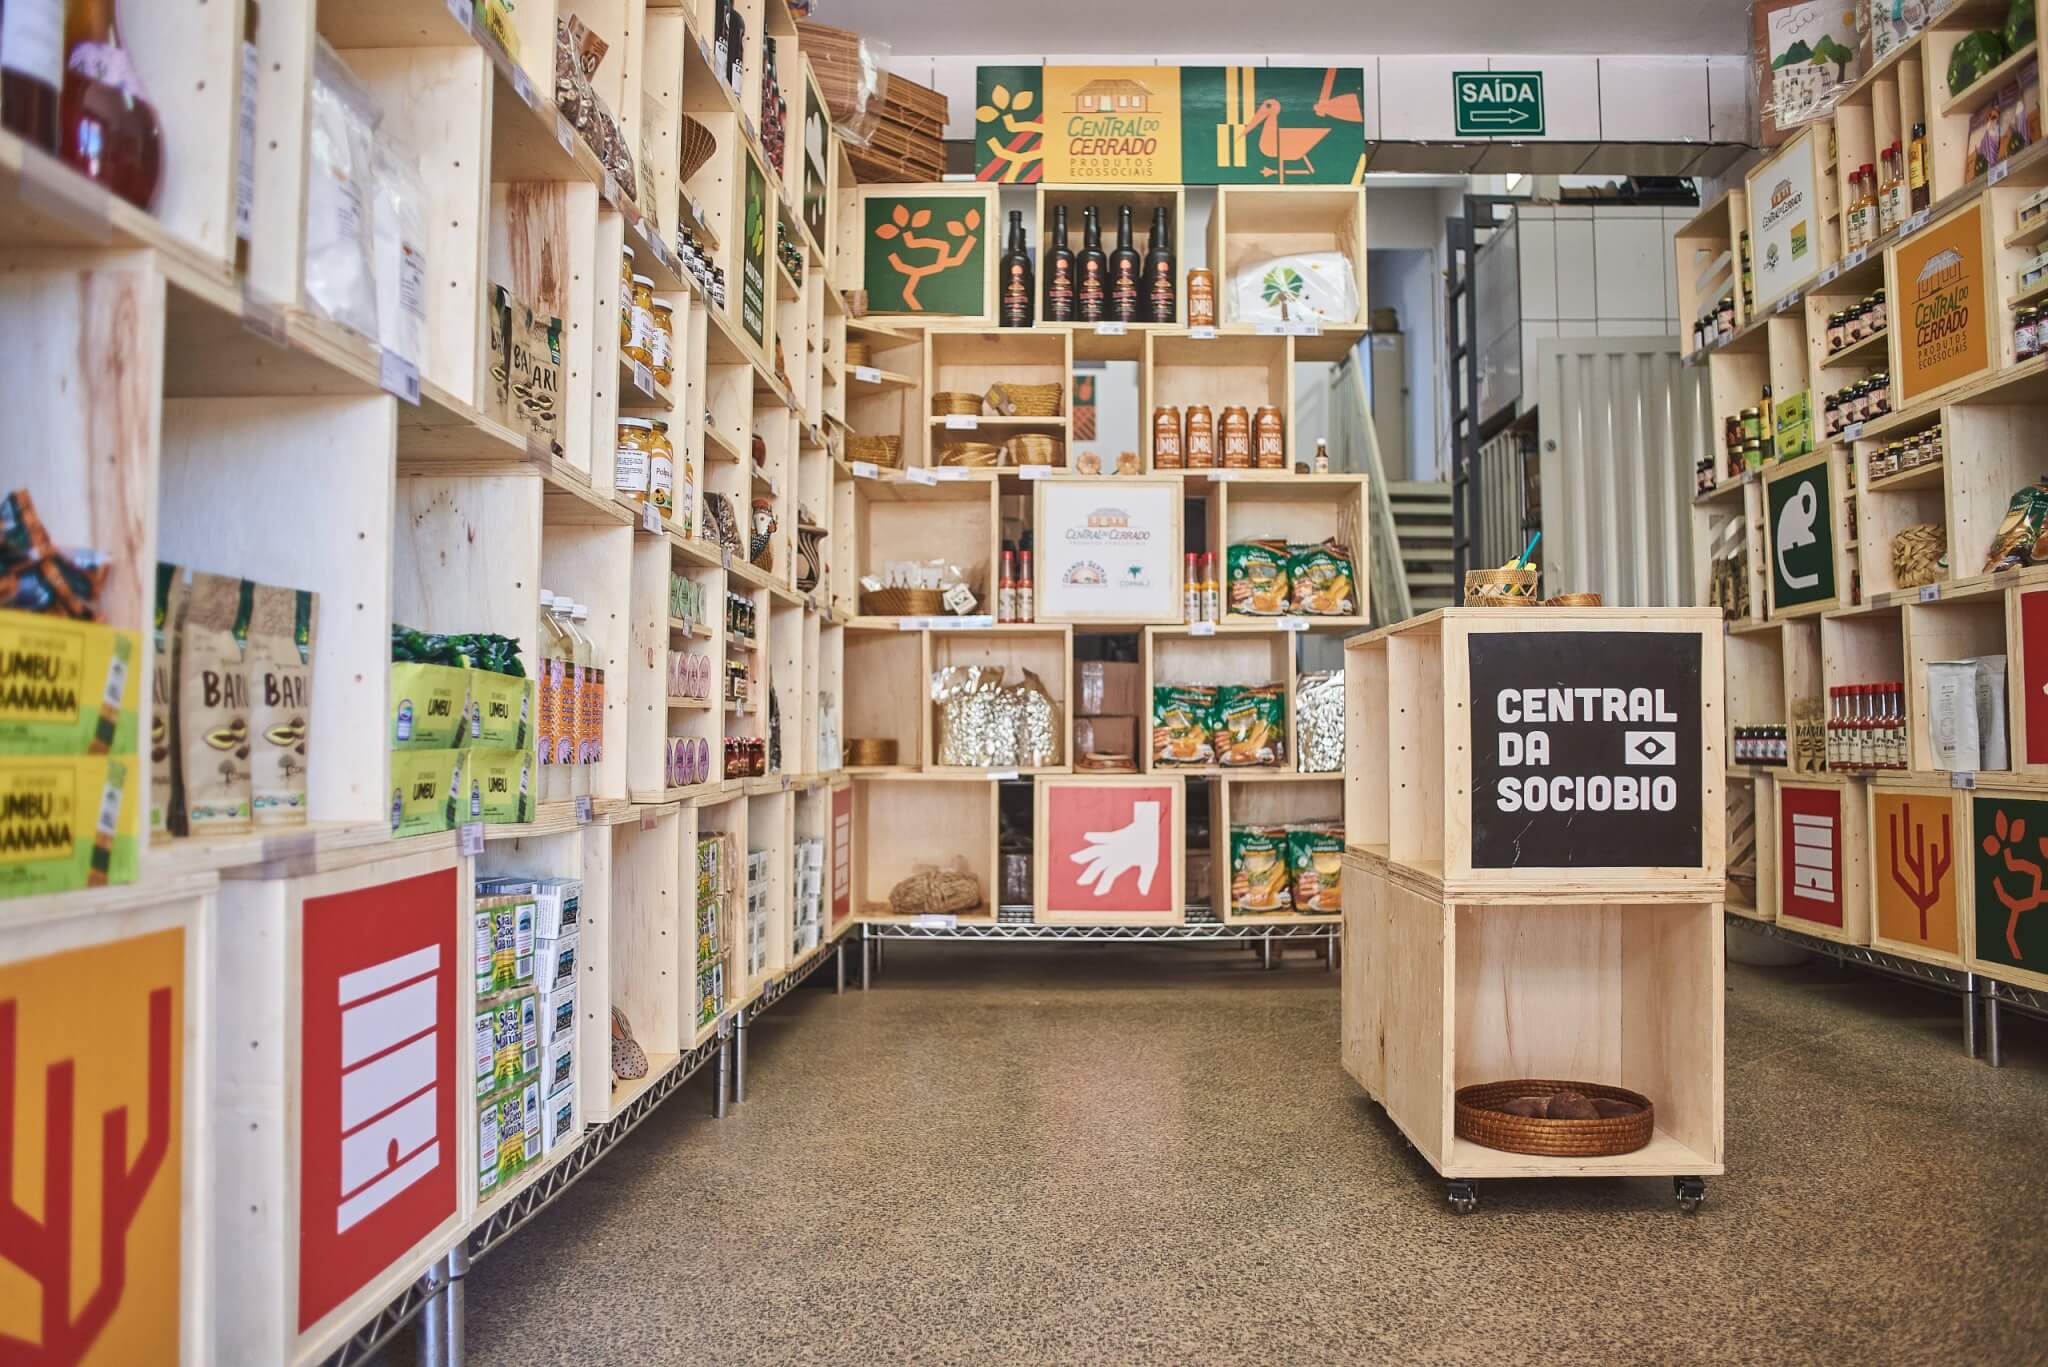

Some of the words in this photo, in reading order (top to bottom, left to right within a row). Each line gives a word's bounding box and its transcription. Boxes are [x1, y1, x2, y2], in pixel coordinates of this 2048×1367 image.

[1462, 78, 1535, 103] SAÍDA
[1067, 116, 1146, 137] CENTRAL
[1144, 120, 1160, 131] DO
[1069, 137, 1157, 155] CERRADO
[1070, 158, 1153, 167] PRODUTOS
[1070, 168, 1153, 176] ECOSSOCIAIS
[1915, 286, 1961, 328] CENTRAL
[1959, 286, 1968, 300] DO
[1917, 307, 1968, 347] CERRADO
[1918, 330, 1967, 360] PRODUTOS
[1919, 342, 1967, 370] ECOSSOCIAIS
[1108, 529, 1150, 540] CERRADO
[428, 699, 452, 717] UMBU
[489, 702, 509, 719] UMBU
[1497, 688, 1678, 723] CENTRAL
[1499, 731, 1550, 766] DA
[488, 778, 507, 793] UMBU
[1496, 776, 1677, 812] SOCIOBIO
[0, 823, 72, 852] ANANA
